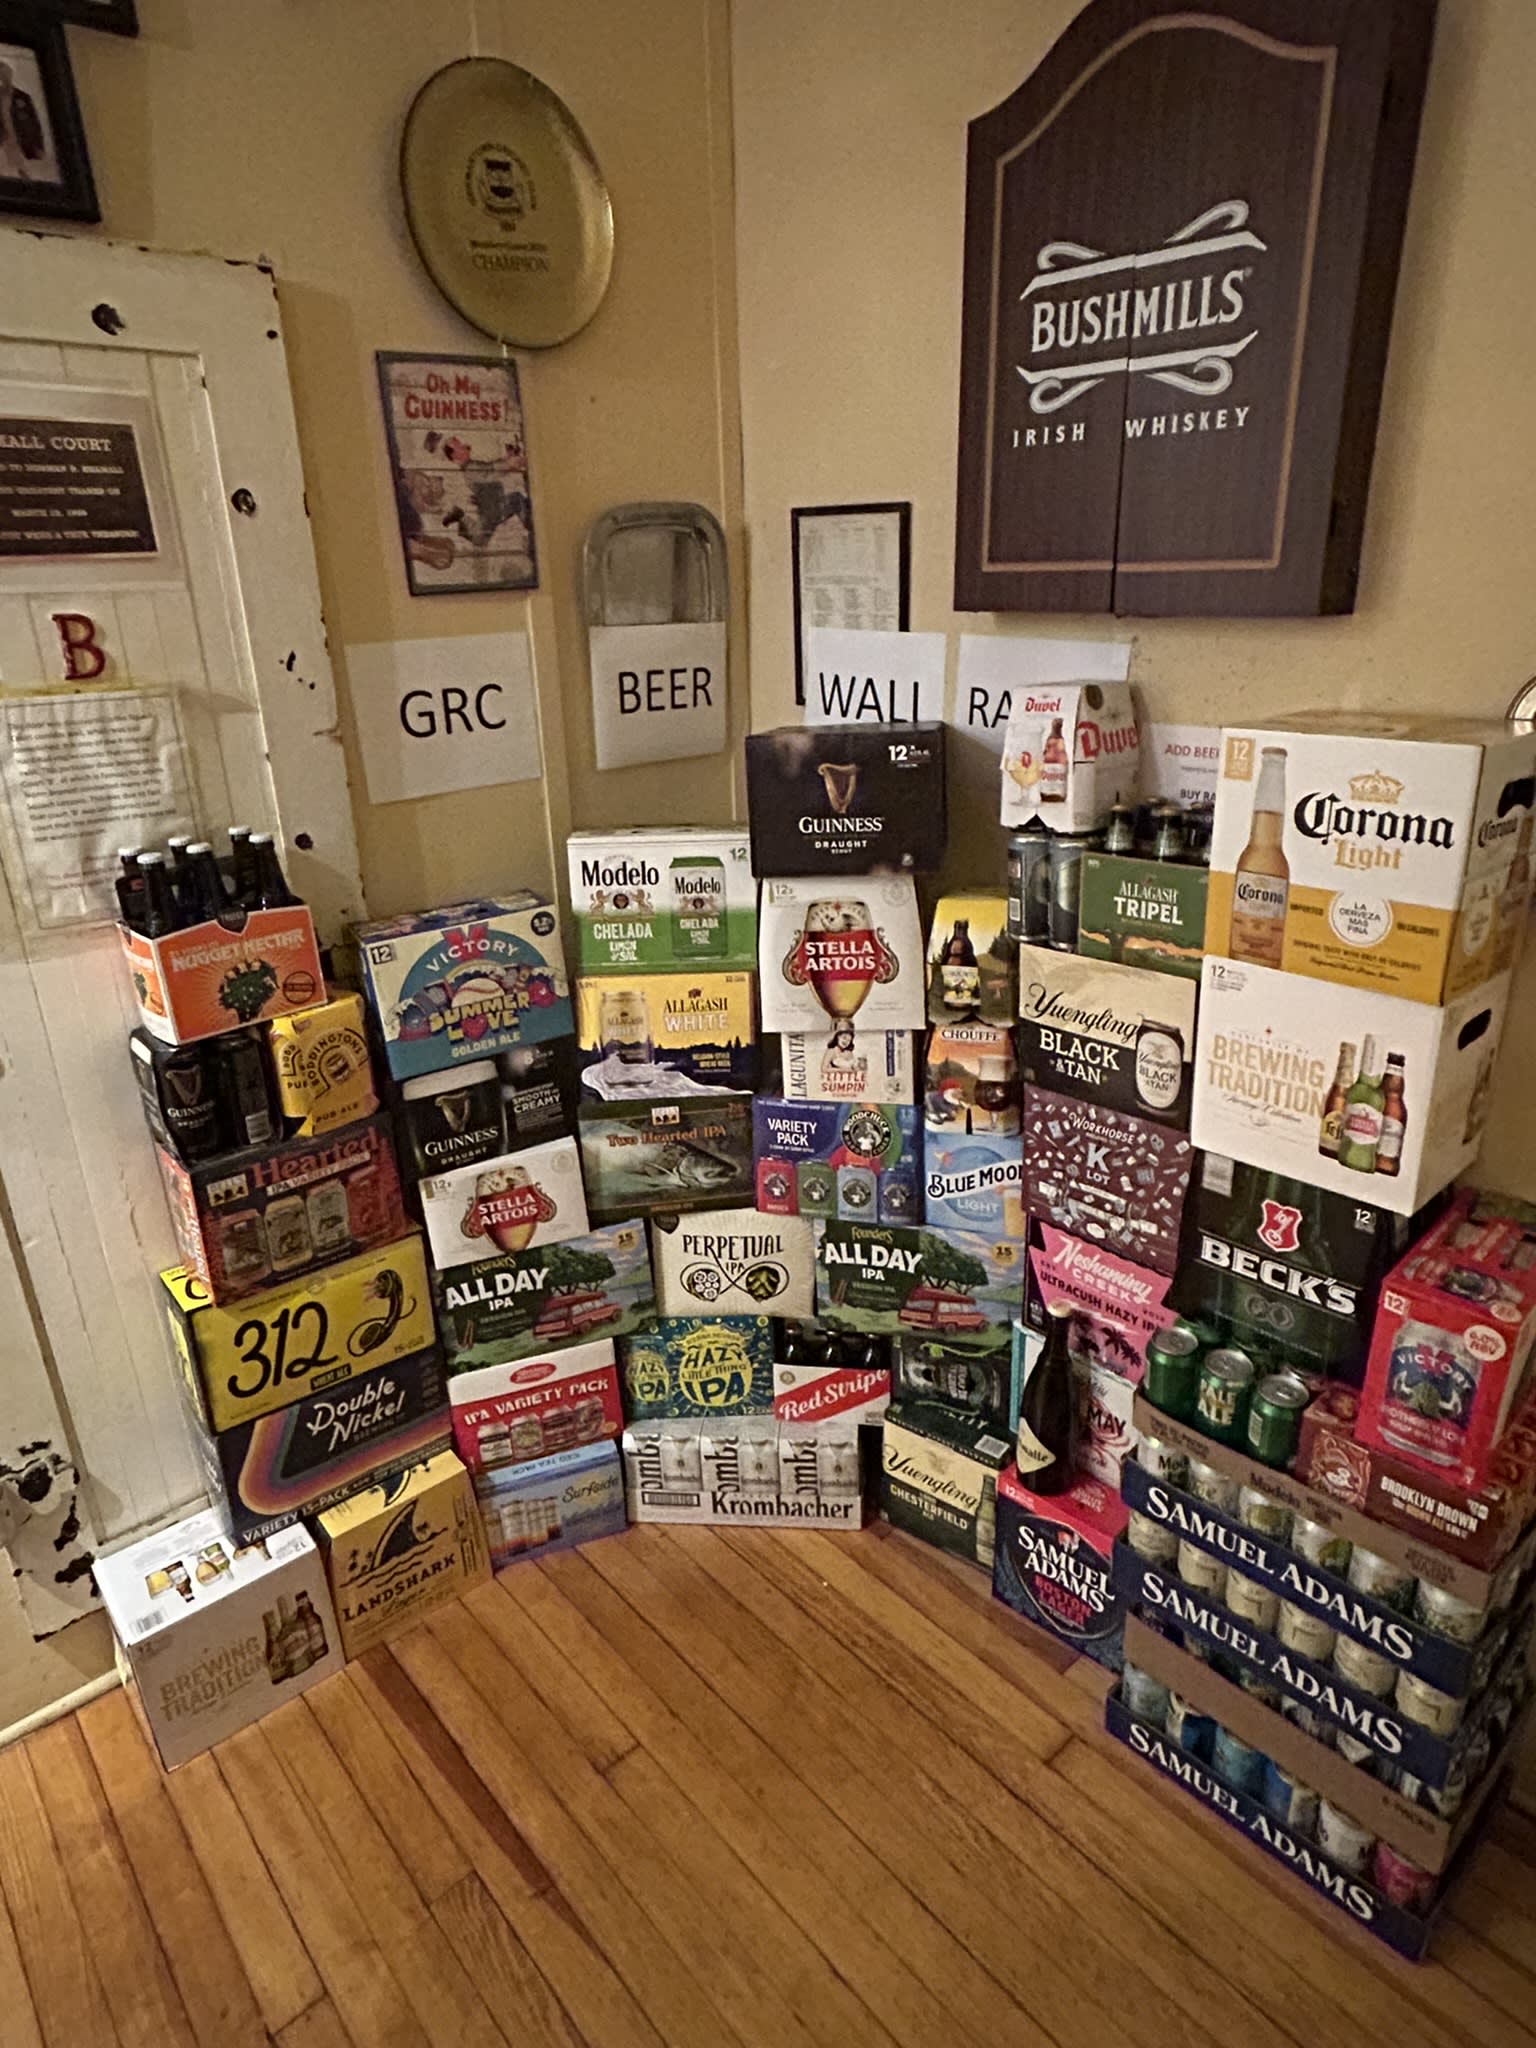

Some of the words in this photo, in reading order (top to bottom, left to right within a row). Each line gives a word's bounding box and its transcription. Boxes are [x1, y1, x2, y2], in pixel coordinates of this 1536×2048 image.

[1032, 269, 1245, 352] BUSHMILLS
[425, 373, 450, 395] Oh
[456, 375, 480, 399] My
[1013, 423, 1085, 448] IRISH
[1125, 406, 1250, 438] WHISKEY
[51, 436, 112, 451] COURT
[52, 613, 106, 681] B
[618, 667, 712, 714] BEER
[400, 683, 507, 738] GRC
[1025, 697, 1062, 713] Duvel
[888, 745, 908, 761] 12
[1165, 744, 1191, 756] ADD
[1232, 741, 1249, 759] 12
[1180, 789, 1200, 800] BUY
[799, 816, 883, 833] GUINNESS
[1294, 791, 1455, 849] Corona
[730, 847, 748, 861] 12
[815, 840, 868, 849] DRAUGHT
[1333, 839, 1403, 870] Light
[581, 860, 660, 887] Modelo
[675, 877, 721, 894] Modelo
[1119, 880, 1179, 905] ALLAGASH
[1238, 881, 1284, 906] Corona
[1354, 902, 1368, 910] LA
[680, 917, 719, 930] CHELADA
[1114, 896, 1184, 926] TRIPEL
[593, 923, 653, 940] CHELADA
[371, 947, 392, 963] 12
[426, 939, 520, 972] VICTORY
[805, 941, 875, 955] STELLA
[804, 956, 876, 971] ARTOIS
[1210, 964, 1226, 979] 12
[429, 991, 531, 1032] SUMMER
[664, 997, 729, 1014] ALLAGASH
[1024, 982, 1138, 1044] Yuengling
[664, 1013, 729, 1033] WHITE
[451, 1039, 497, 1058] GOLDEN
[500, 1031, 521, 1045] ALE
[1039, 1029, 1121, 1071] BLACK
[1138, 1065, 1177, 1084] BLACK
[1213, 1034, 1325, 1088] BREWING
[513, 1089, 551, 1106] SMOOTH
[822, 1083, 866, 1093] SUMPIN
[1207, 1059, 1328, 1119] TRADITION
[316, 1110, 338, 1123] PUB
[341, 1102, 360, 1115] ALE
[514, 1093, 561, 1113] CREAMY
[607, 1135, 639, 1148] Two
[642, 1128, 698, 1145] Hearted
[704, 1125, 727, 1138] IPA
[768, 1118, 818, 1134] VARIETY
[777, 1131, 809, 1146] PACK
[1068, 1112, 1135, 1146] WORKHORSE
[425, 1125, 499, 1157] GUINNESS
[252, 1126, 380, 1188] Hearted
[1087, 1142, 1111, 1173] K
[928, 1171, 976, 1199] BLUE
[1086, 1169, 1111, 1185] LOT
[479, 1193, 537, 1215] STELLA
[481, 1204, 538, 1226] ARTOIS
[956, 1198, 999, 1213] LIGHT
[1355, 1208, 1372, 1224] 12
[618, 1234, 634, 1245] 15
[683, 1235, 784, 1261] PERPETUAL
[996, 1246, 1012, 1257] 15
[726, 1262, 745, 1275] IPA
[825, 1243, 867, 1265] ALL
[871, 1244, 924, 1274] DAY
[446, 1278, 494, 1309] ALL
[495, 1267, 549, 1296] DAY
[862, 1268, 886, 1281] IPA
[1073, 1268, 1131, 1302] CREEK
[1199, 1234, 1357, 1316] BECK'S
[489, 1296, 514, 1312] IPA
[1041, 1270, 1102, 1309] ULTRACUSH
[1105, 1303, 1139, 1326] HAZY
[1386, 1294, 1406, 1313] 12
[228, 1301, 338, 1398] 312
[684, 1346, 744, 1369] HAZY
[1397, 1353, 1472, 1389] VICTORY
[684, 1371, 746, 1404] IPA
[779, 1395, 824, 1420] Red
[823, 1369, 890, 1404] Stripe
[306, 1376, 396, 1437] Double
[464, 1411, 490, 1426] IPA
[494, 1386, 564, 1416] VARIETY
[569, 1378, 608, 1396] PACK
[1197, 1399, 1234, 1427] ALE
[328, 1390, 406, 1452] Nickel
[562, 1475, 620, 1503] Surfside
[885, 1444, 979, 1509] Yuengling
[1005, 1484, 1016, 1497] 12
[1380, 1475, 1436, 1514] BROOKLYN
[1436, 1501, 1479, 1533] BROWN
[711, 1491, 853, 1520] Krombacher
[890, 1483, 969, 1531] CHESTERFIELD
[243, 1512, 299, 1542] VARIETY
[1018, 1525, 1116, 1601] SAMUEL
[1146, 1486, 1275, 1575] SAMUEL
[1280, 1562, 1415, 1662] ADAMS
[342, 1552, 457, 1623] LANDSHARK
[1024, 1552, 1105, 1613] ADAMS
[159, 1636, 261, 1701] BREWING
[1141, 1572, 1266, 1665] SAMUEL
[1271, 1655, 1405, 1756] ADAMS
[1129, 1723, 1247, 1823] SAMUEL
[1250, 1814, 1375, 1921] ADAMS
